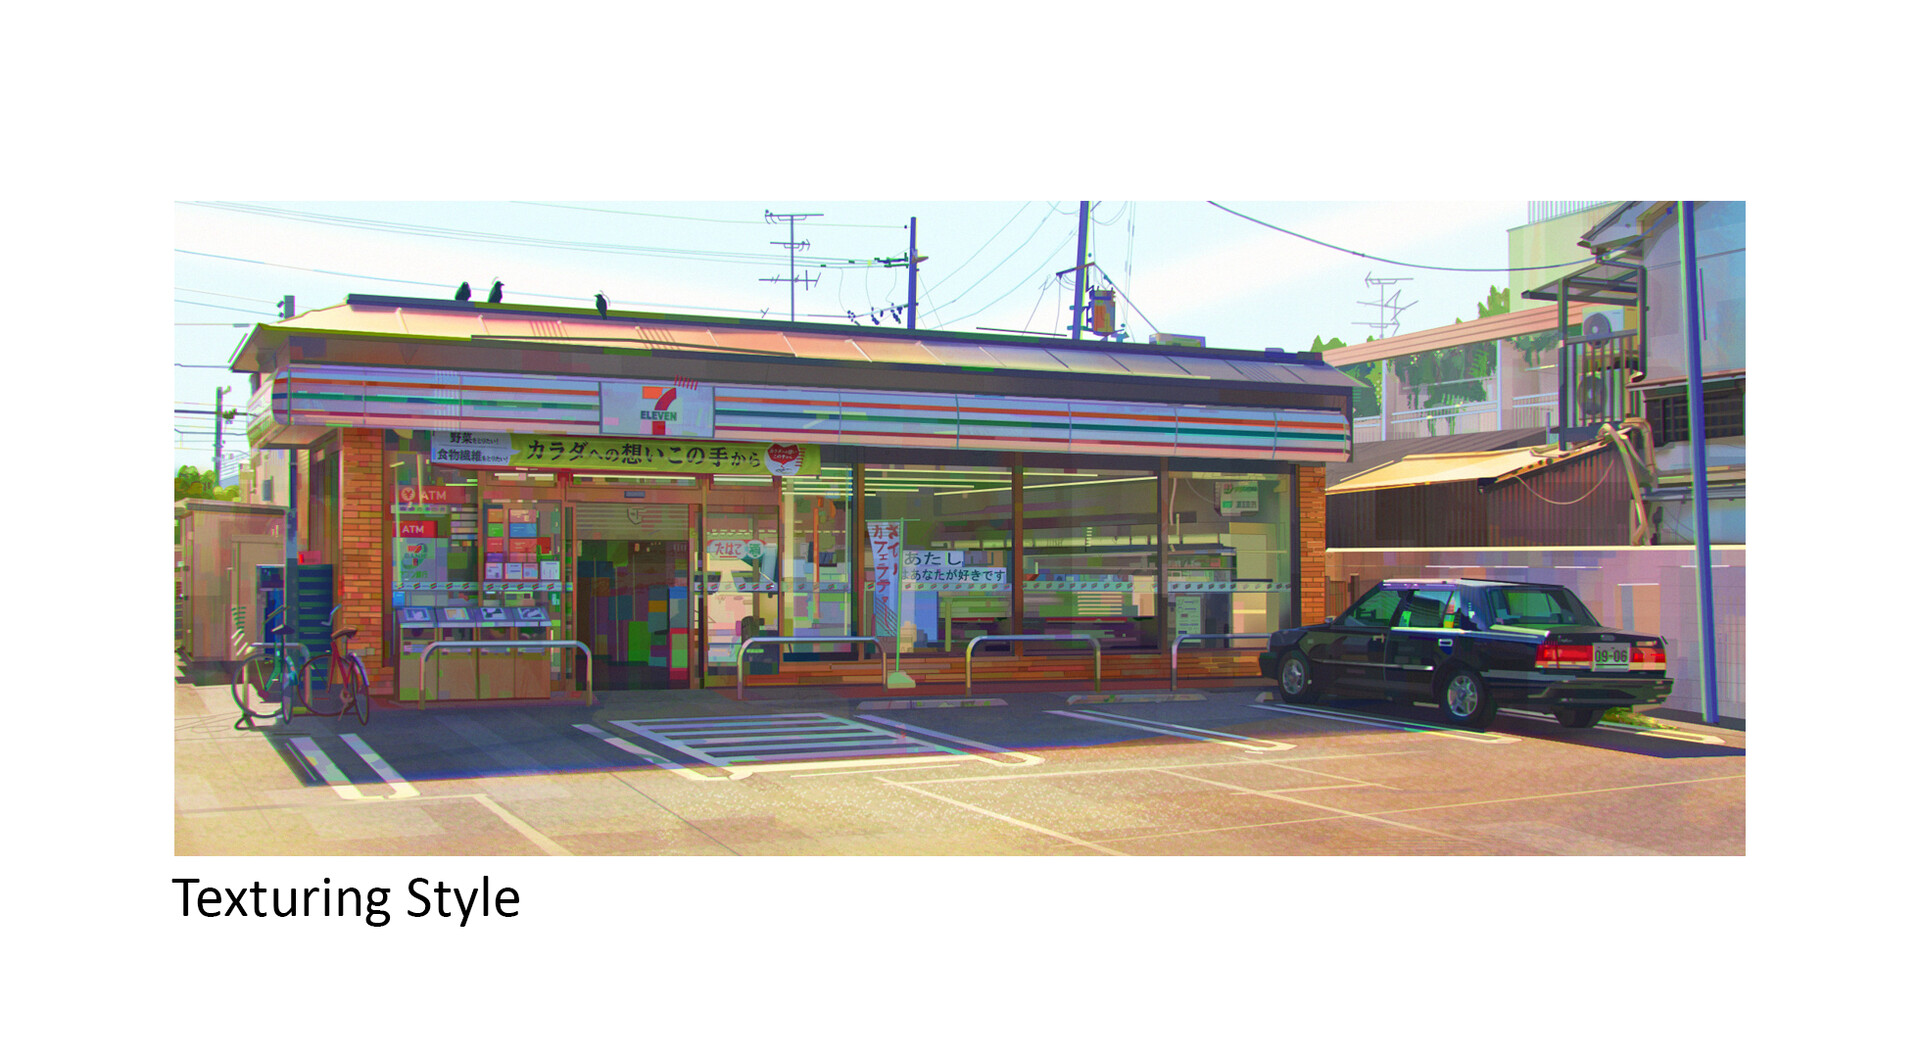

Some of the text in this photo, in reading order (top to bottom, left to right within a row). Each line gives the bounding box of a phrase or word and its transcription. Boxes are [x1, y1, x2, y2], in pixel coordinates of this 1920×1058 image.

[641, 410, 677, 420] ELEVEN
[527, 440, 760, 467] カラダへの想いこの手から
[421, 490, 446, 500] ATM
[402, 525, 424, 533] ATM
[904, 551, 962, 566] あたし
[1595, 650, 1628, 662] 09-06
